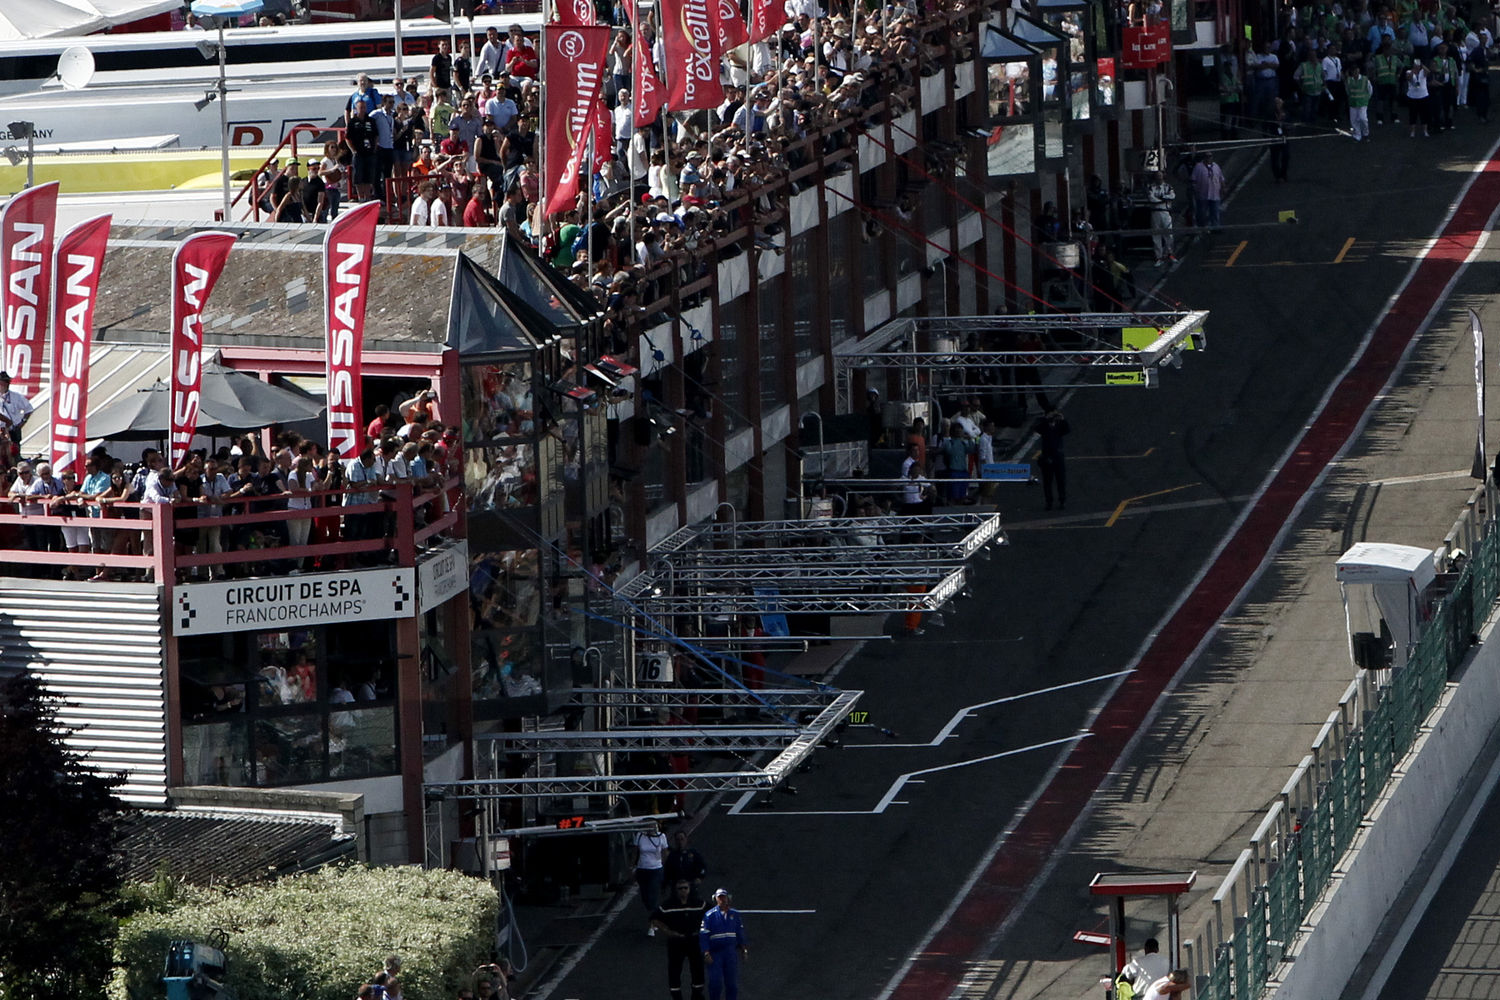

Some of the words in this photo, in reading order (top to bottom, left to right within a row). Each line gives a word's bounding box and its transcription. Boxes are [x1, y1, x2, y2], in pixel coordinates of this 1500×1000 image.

[684, 52, 695, 104] TOTAL
[0, 129, 54, 141] GEANY
[5, 222, 45, 398] ISSAN
[52, 254, 95, 476] NISSAN
[328, 242, 365, 458] NISSAN
[225, 583, 296, 606] CIRCUIT
[299, 582, 324, 600] DE
[327, 578, 363, 599] SPA
[849, 711, 868, 724] 107
[559, 816, 585, 829] #7
